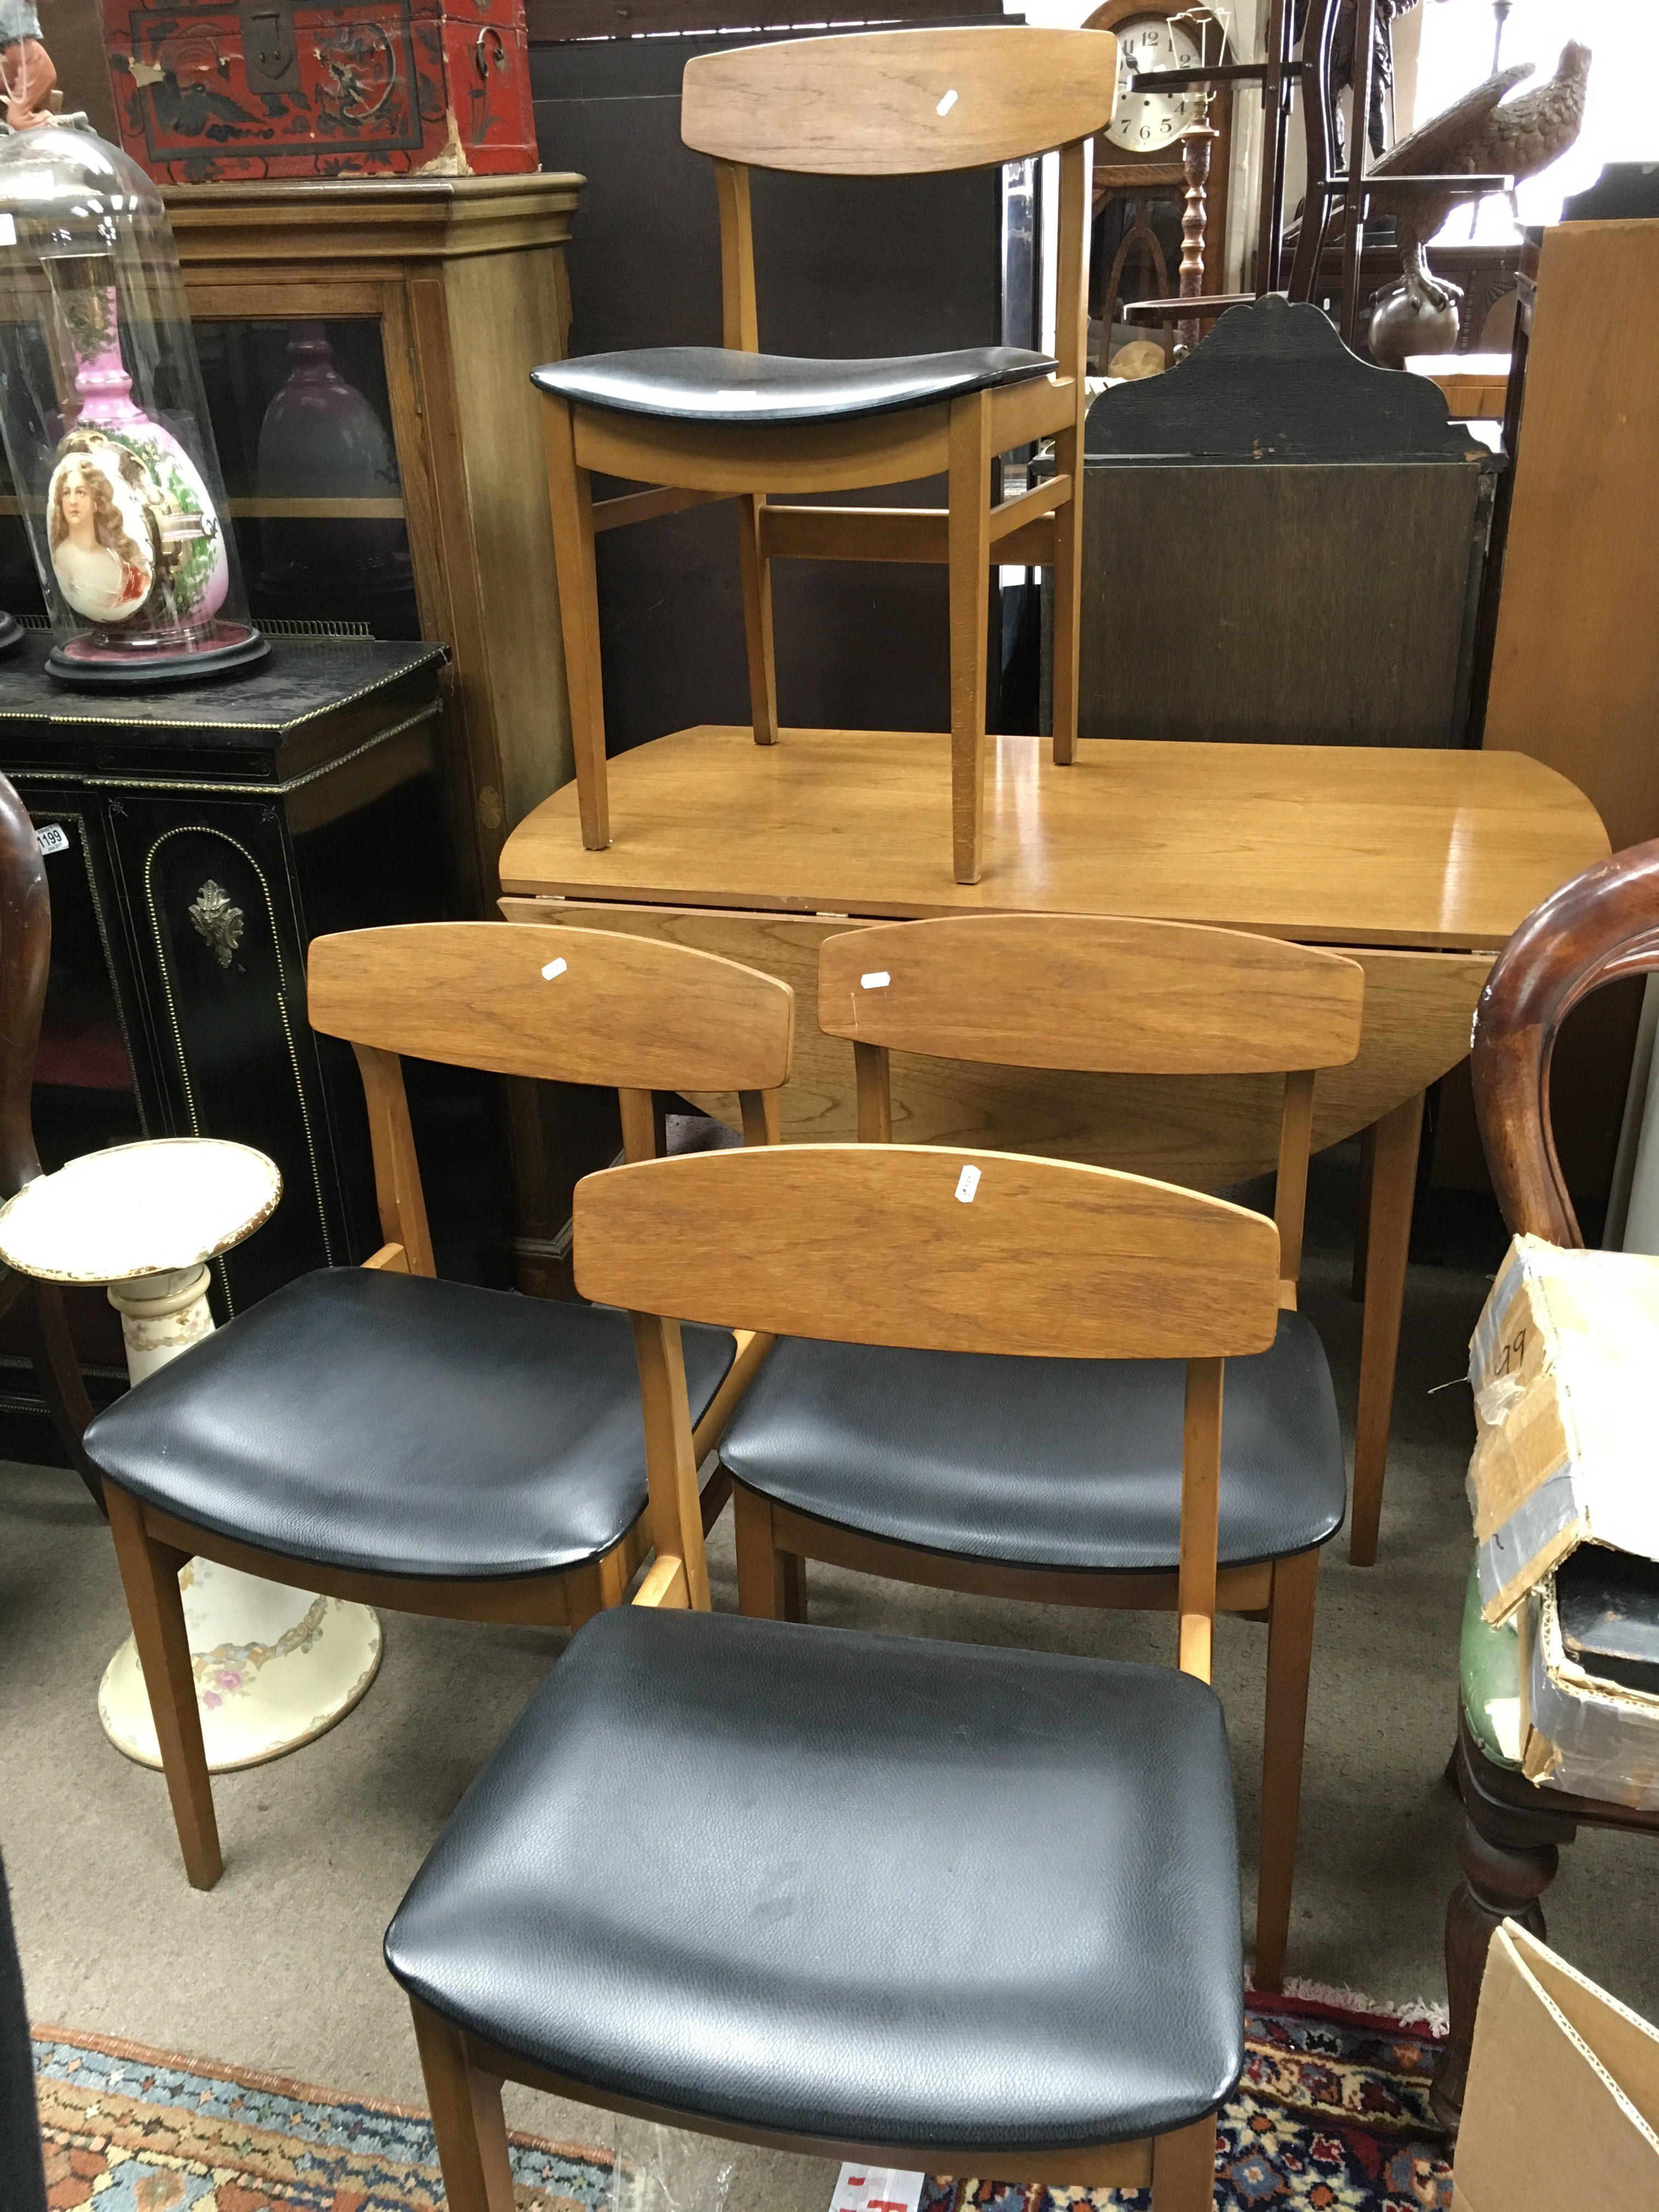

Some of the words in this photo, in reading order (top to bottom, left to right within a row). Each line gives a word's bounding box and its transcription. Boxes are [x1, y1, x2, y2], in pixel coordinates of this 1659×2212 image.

[1142, 32, 1159, 46] 12
[1123, 40, 1134, 54] 11
[1180, 54, 1191, 69] 2
[1175, 101, 1186, 115] 4
[1121, 119, 1132, 134] 7
[1139, 125, 1150, 139] 6
[1160, 119, 1172, 133] 5
[37, 830, 62, 848] 1199
